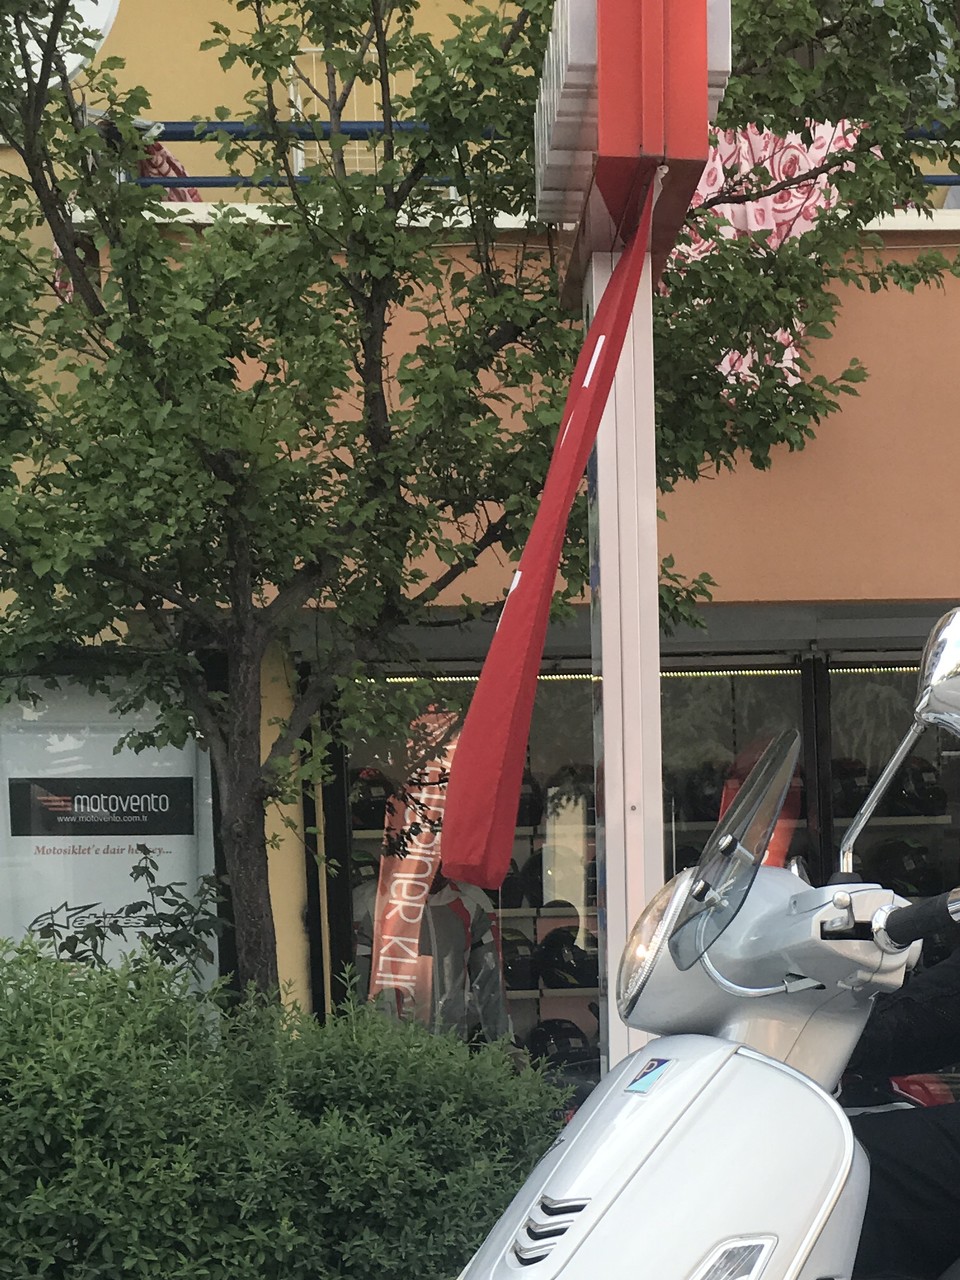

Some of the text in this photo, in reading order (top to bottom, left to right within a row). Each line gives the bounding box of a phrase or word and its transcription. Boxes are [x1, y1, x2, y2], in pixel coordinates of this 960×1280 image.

[74, 794, 170, 813] motovento
[57, 815, 148, 823] www.motovento.com.tr
[102, 845, 126, 855] dair
